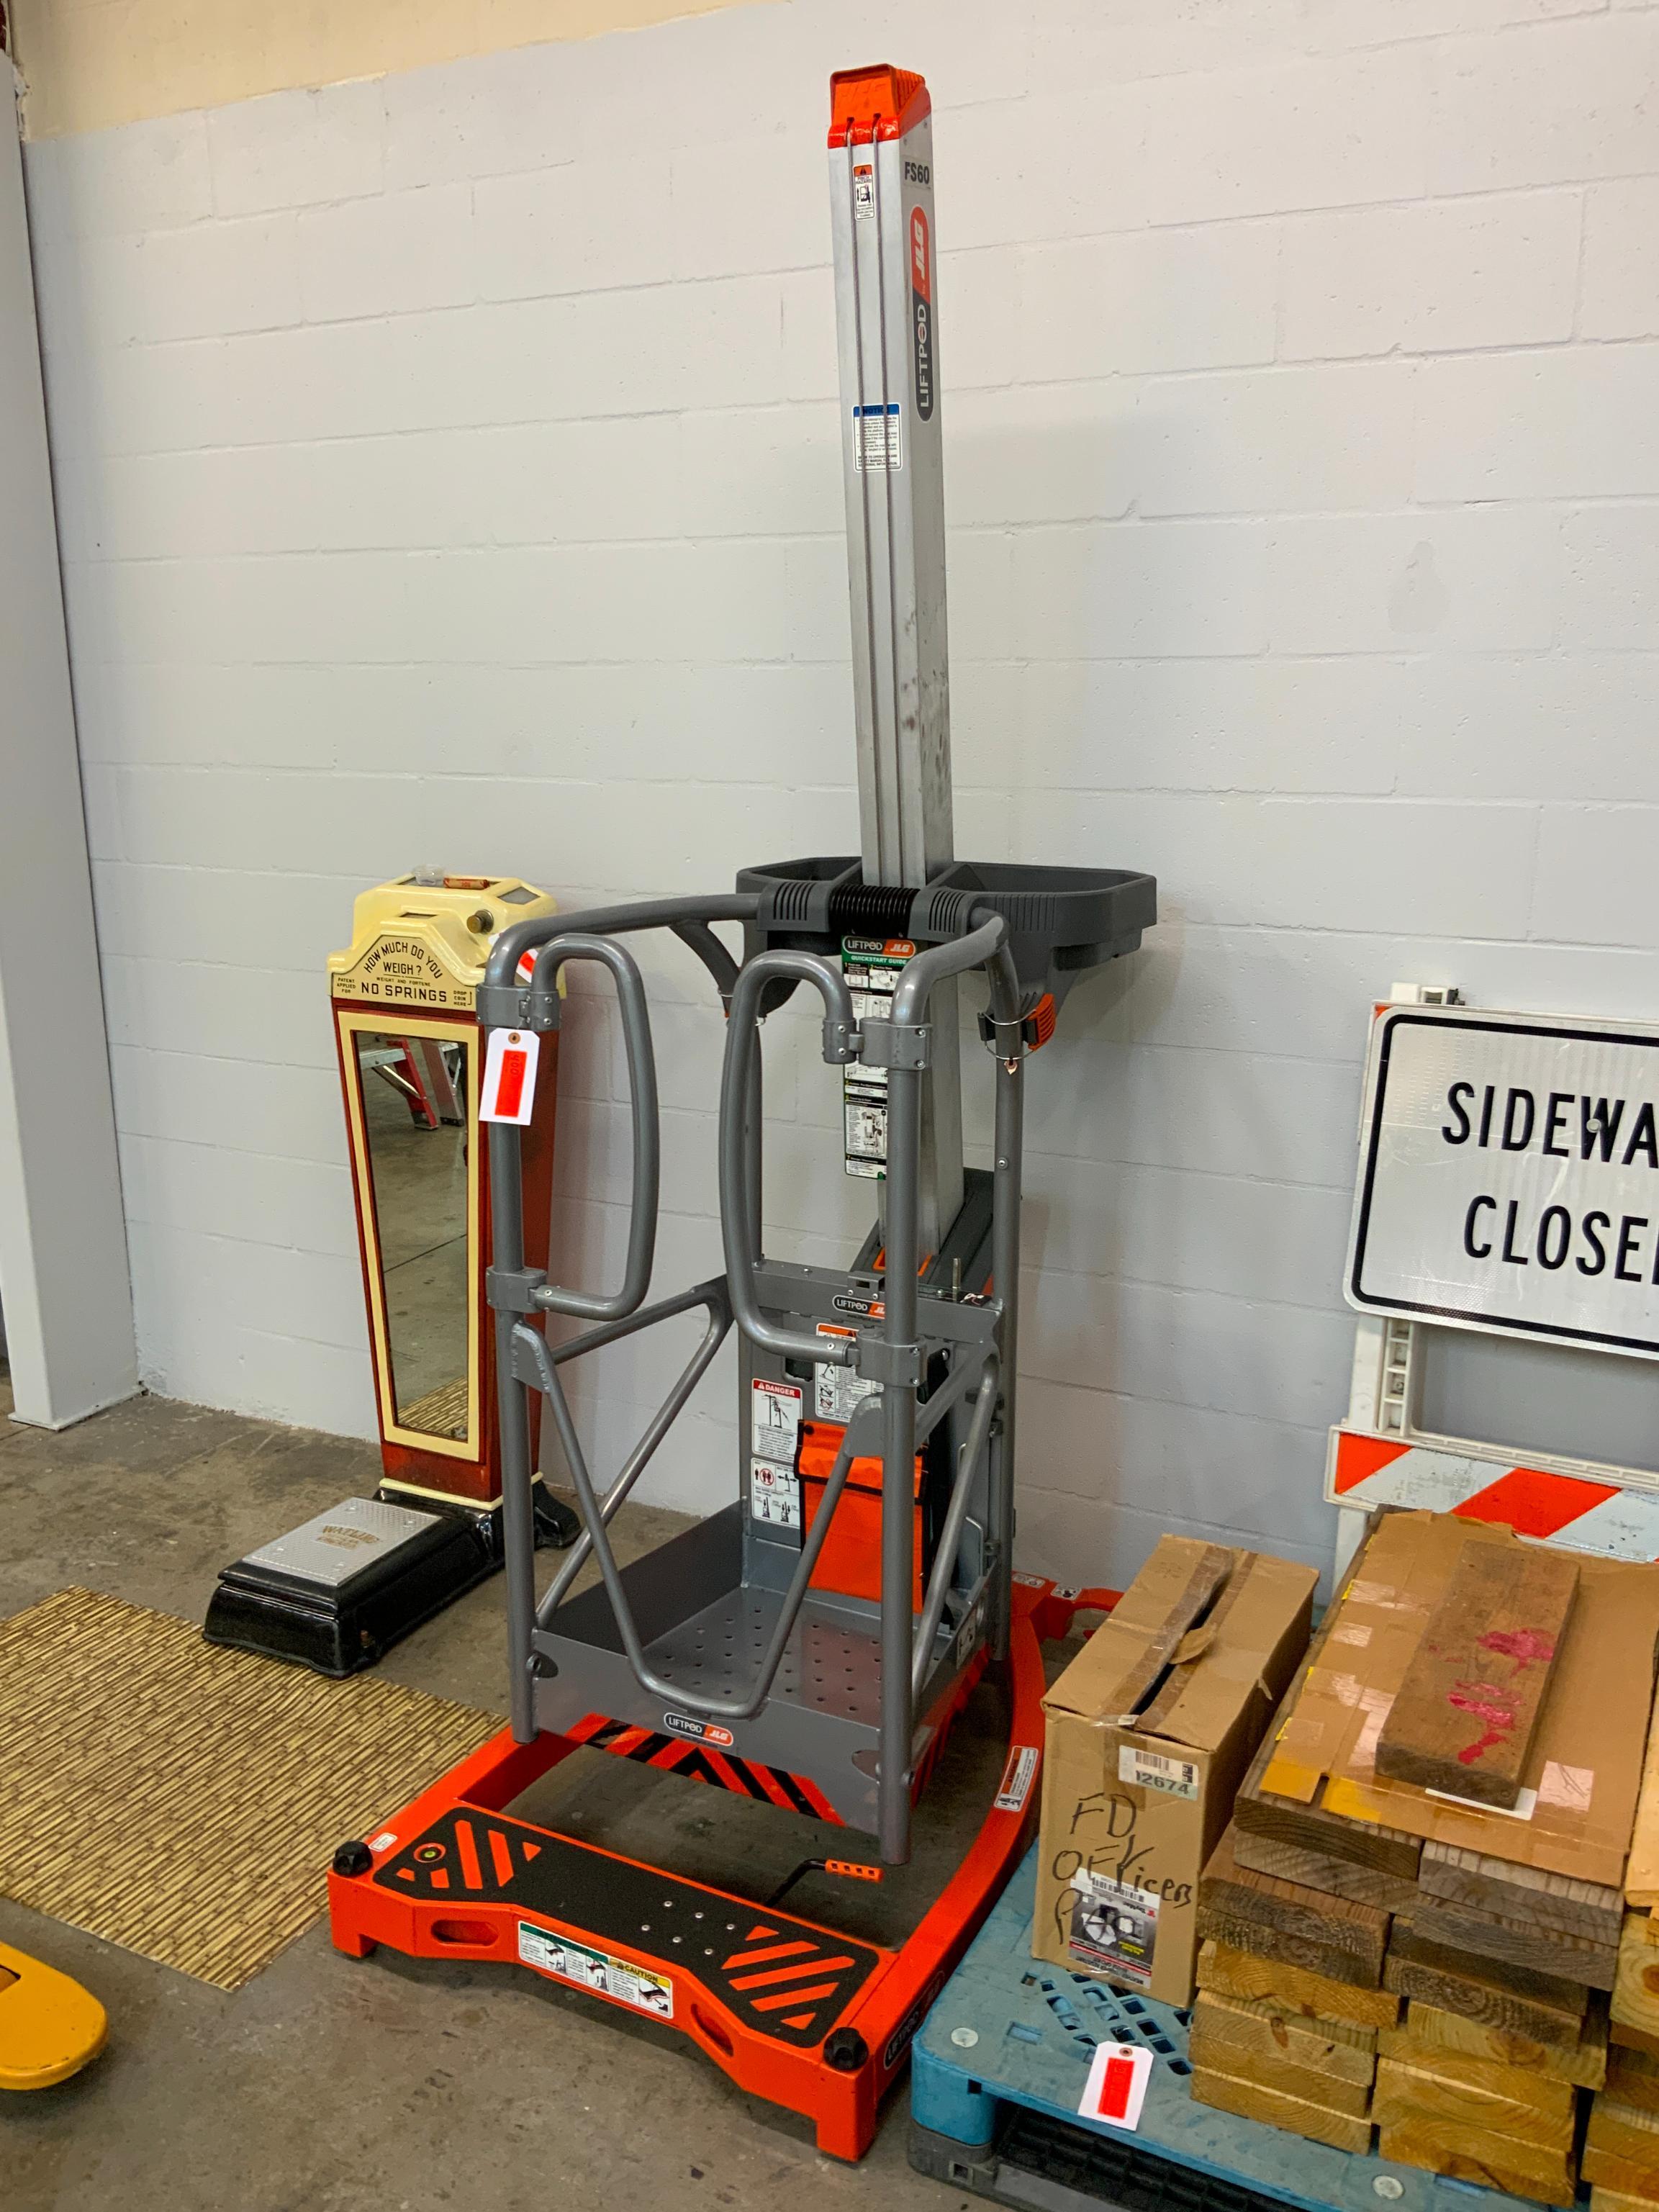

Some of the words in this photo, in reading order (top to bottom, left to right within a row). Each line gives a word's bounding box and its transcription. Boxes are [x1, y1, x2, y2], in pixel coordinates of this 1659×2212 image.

[904, 161, 930, 184] FS60
[914, 218, 926, 279] JLG
[916, 303, 929, 408] LIFTPOD
[847, 939, 883, 951] LIFTPOD
[890, 943, 910, 953] JLG
[363, 949, 381, 973] HOW
[381, 942, 408, 957] MUCH
[411, 944, 424, 960] DO
[426, 955, 443, 979] YOU
[361, 982, 379, 995] NO
[385, 985, 447, 1003] SPRINGS
[1442, 1081, 1659, 1170] SIDEWA
[1464, 1195, 1659, 1286] CLOSE
[836, 1299, 868, 1311] LIFTPOD
[765, 1384, 795, 1396] DANGER
[669, 1717, 702, 1733] LIFTPOD
[710, 1730, 729, 1741] JLG
[625, 1965, 659, 1983] CAUTION
